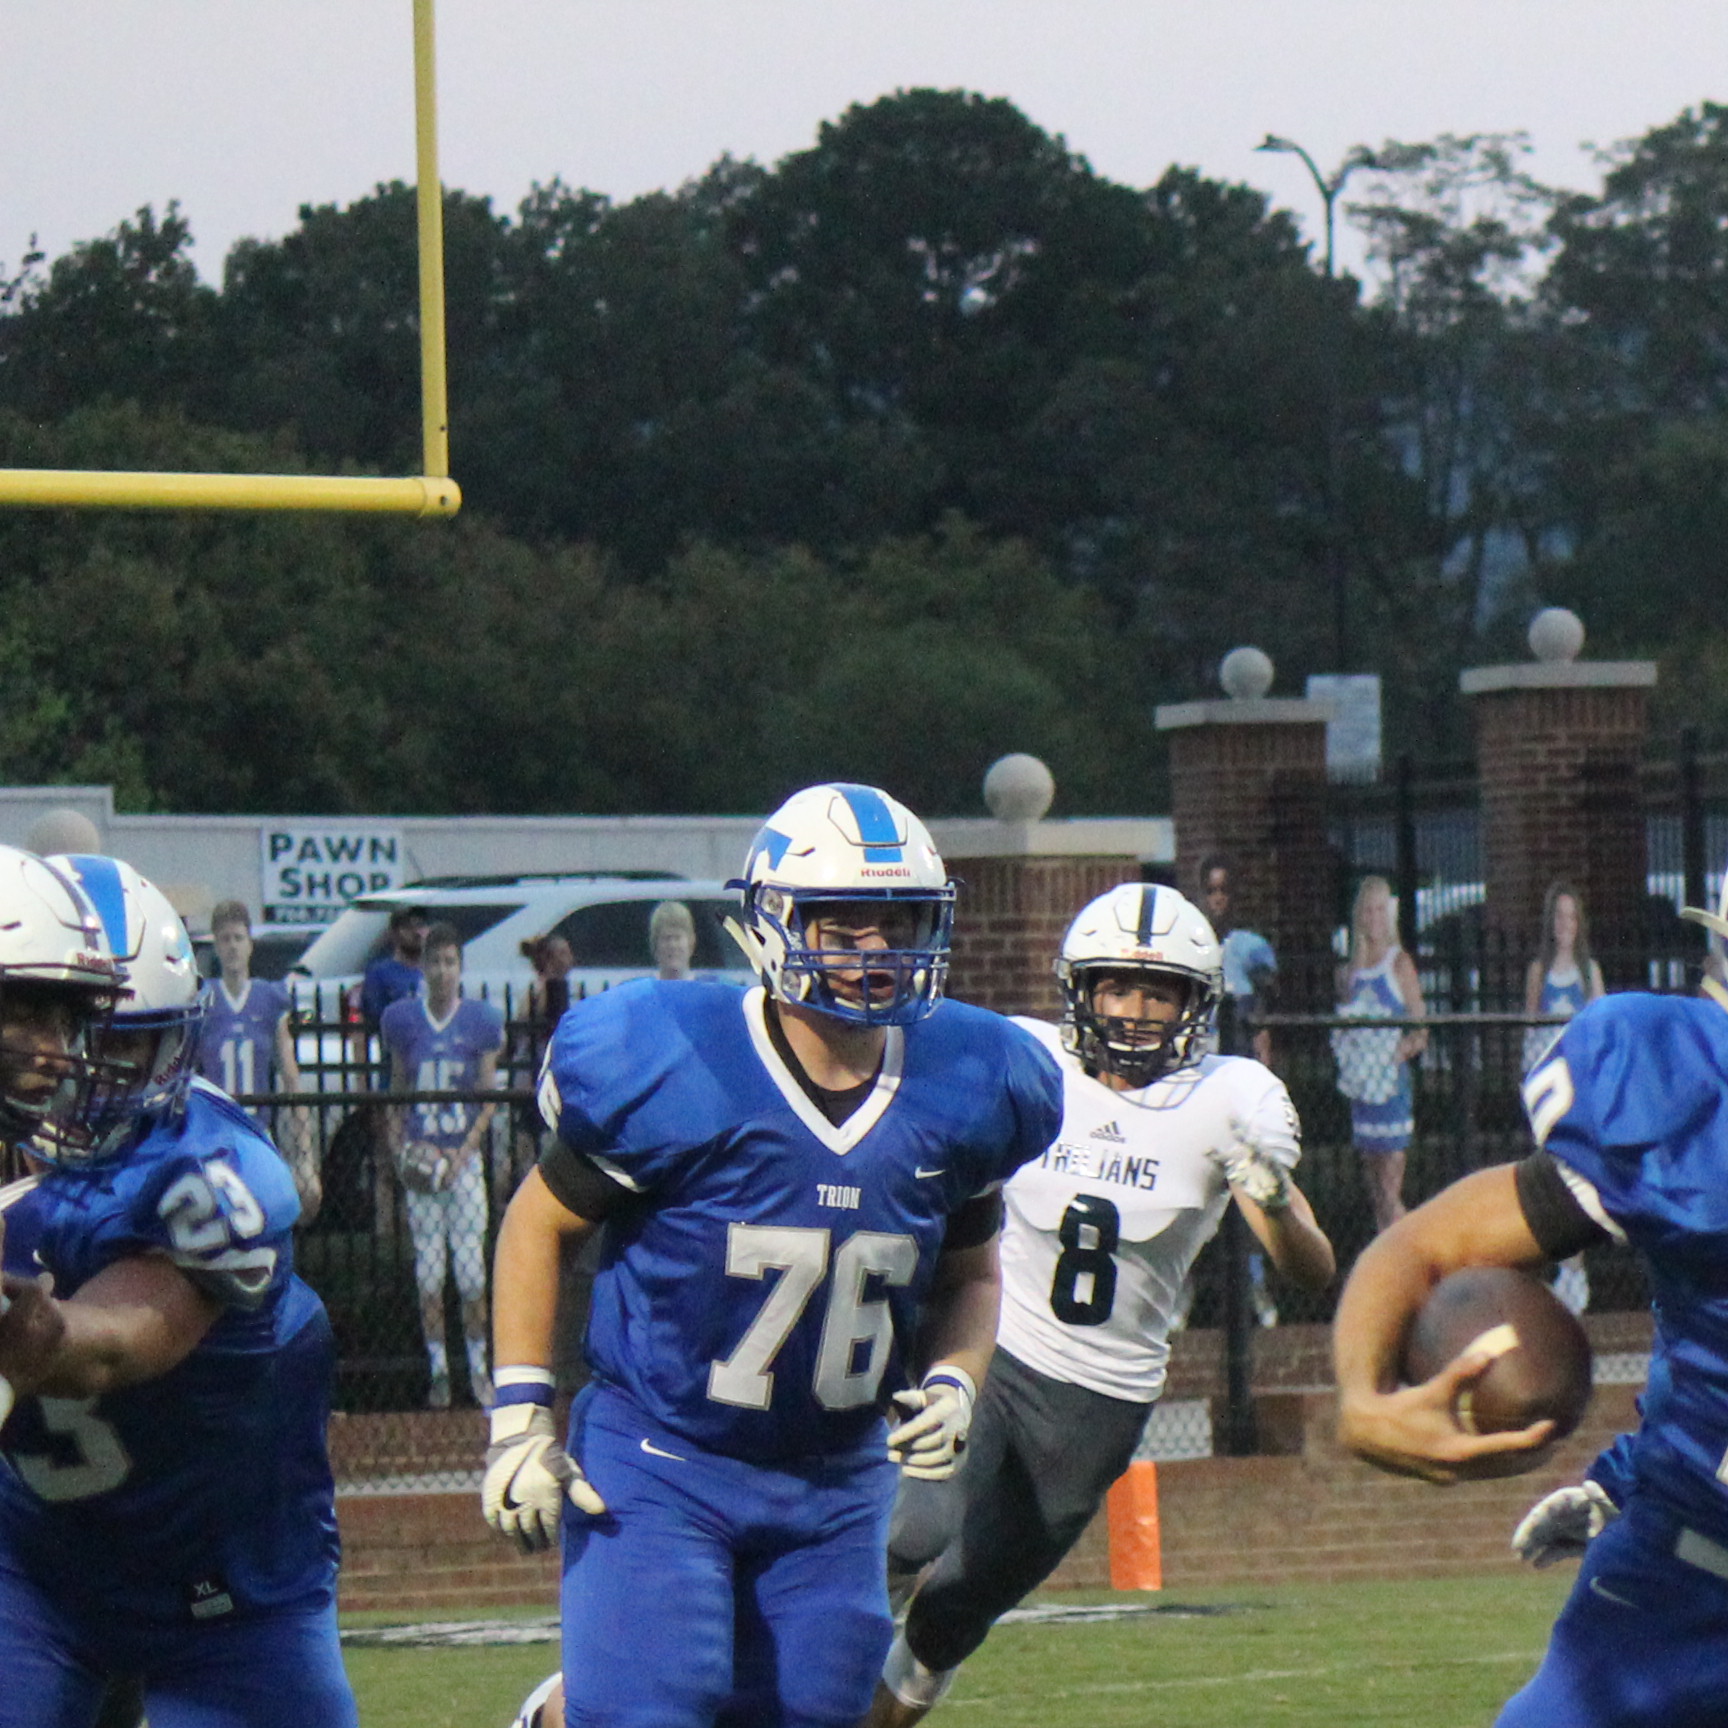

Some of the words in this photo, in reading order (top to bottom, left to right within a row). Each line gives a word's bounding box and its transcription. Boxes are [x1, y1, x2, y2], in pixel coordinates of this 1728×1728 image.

[269, 833, 397, 864] PAWN
[279, 867, 391, 900] SHOP
[817, 1183, 862, 1210] TRION
[1050, 1192, 1121, 1326] 8
[706, 1221, 921, 1413] 76
[193, 1580, 219, 1597] XL
